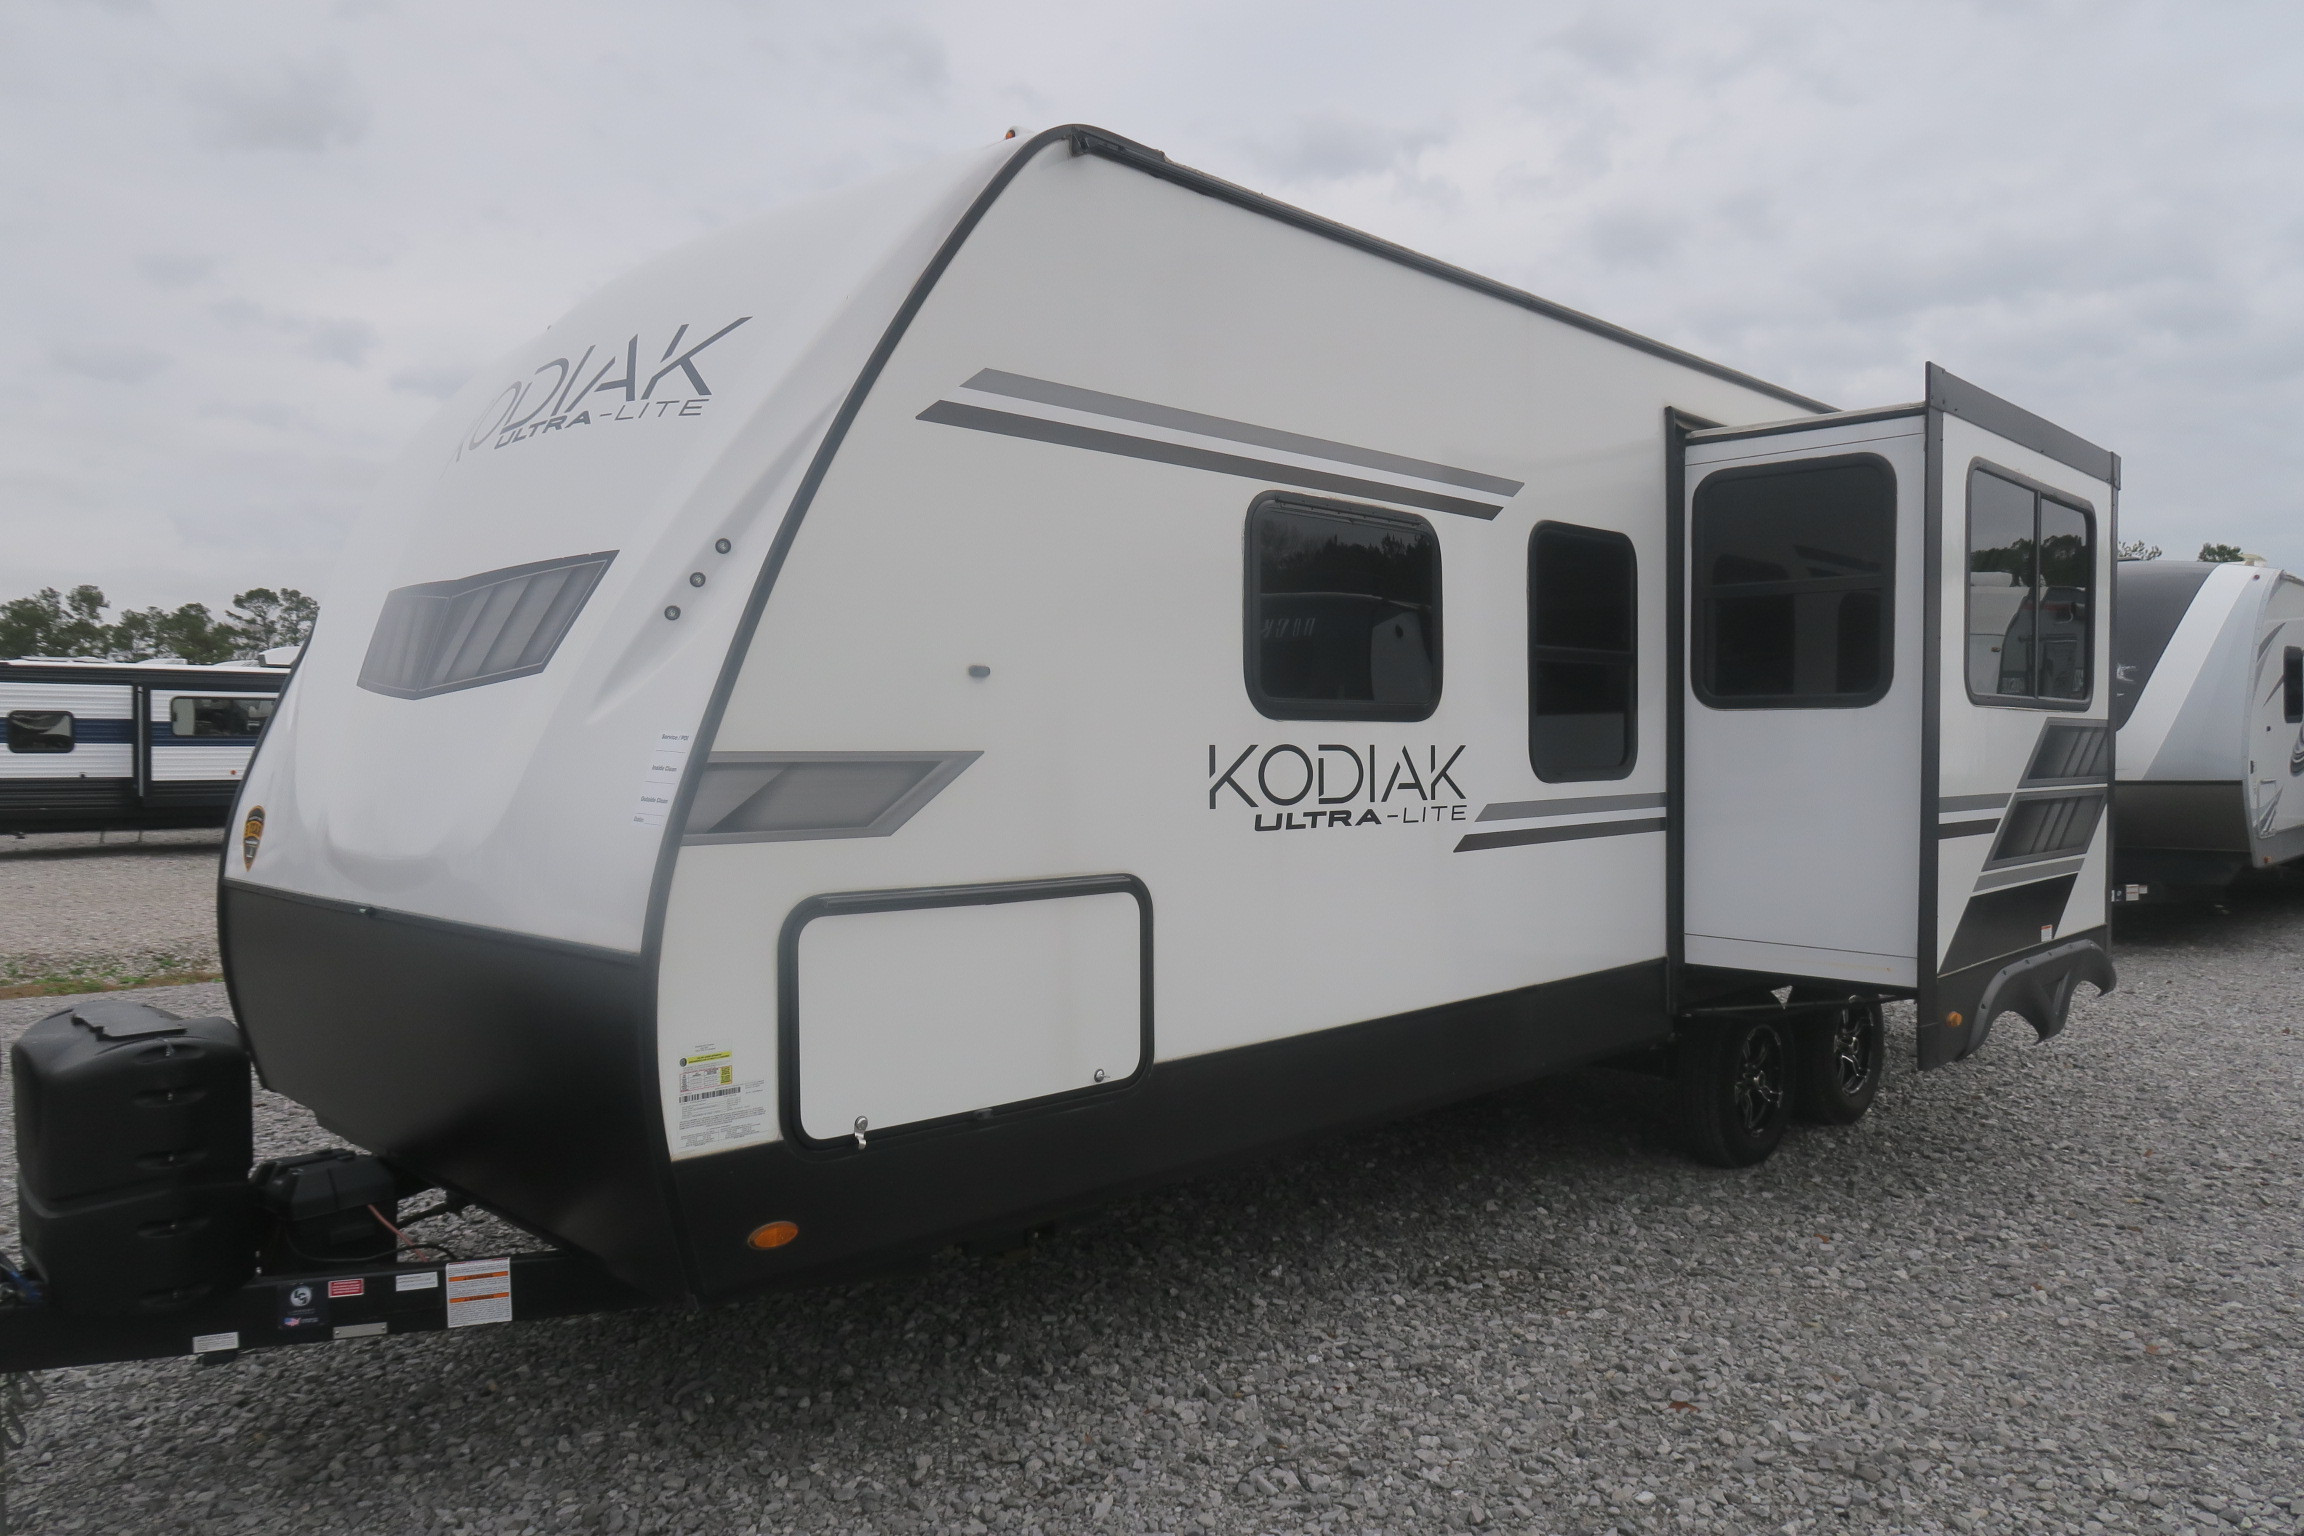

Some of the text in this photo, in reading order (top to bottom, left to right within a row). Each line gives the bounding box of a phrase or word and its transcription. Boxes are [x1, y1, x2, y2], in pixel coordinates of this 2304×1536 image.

[494, 398, 710, 450] ULTRA-LITE
[1209, 743, 1467, 810] KODIAK
[1254, 805, 1468, 832] ULTRA-LITE
